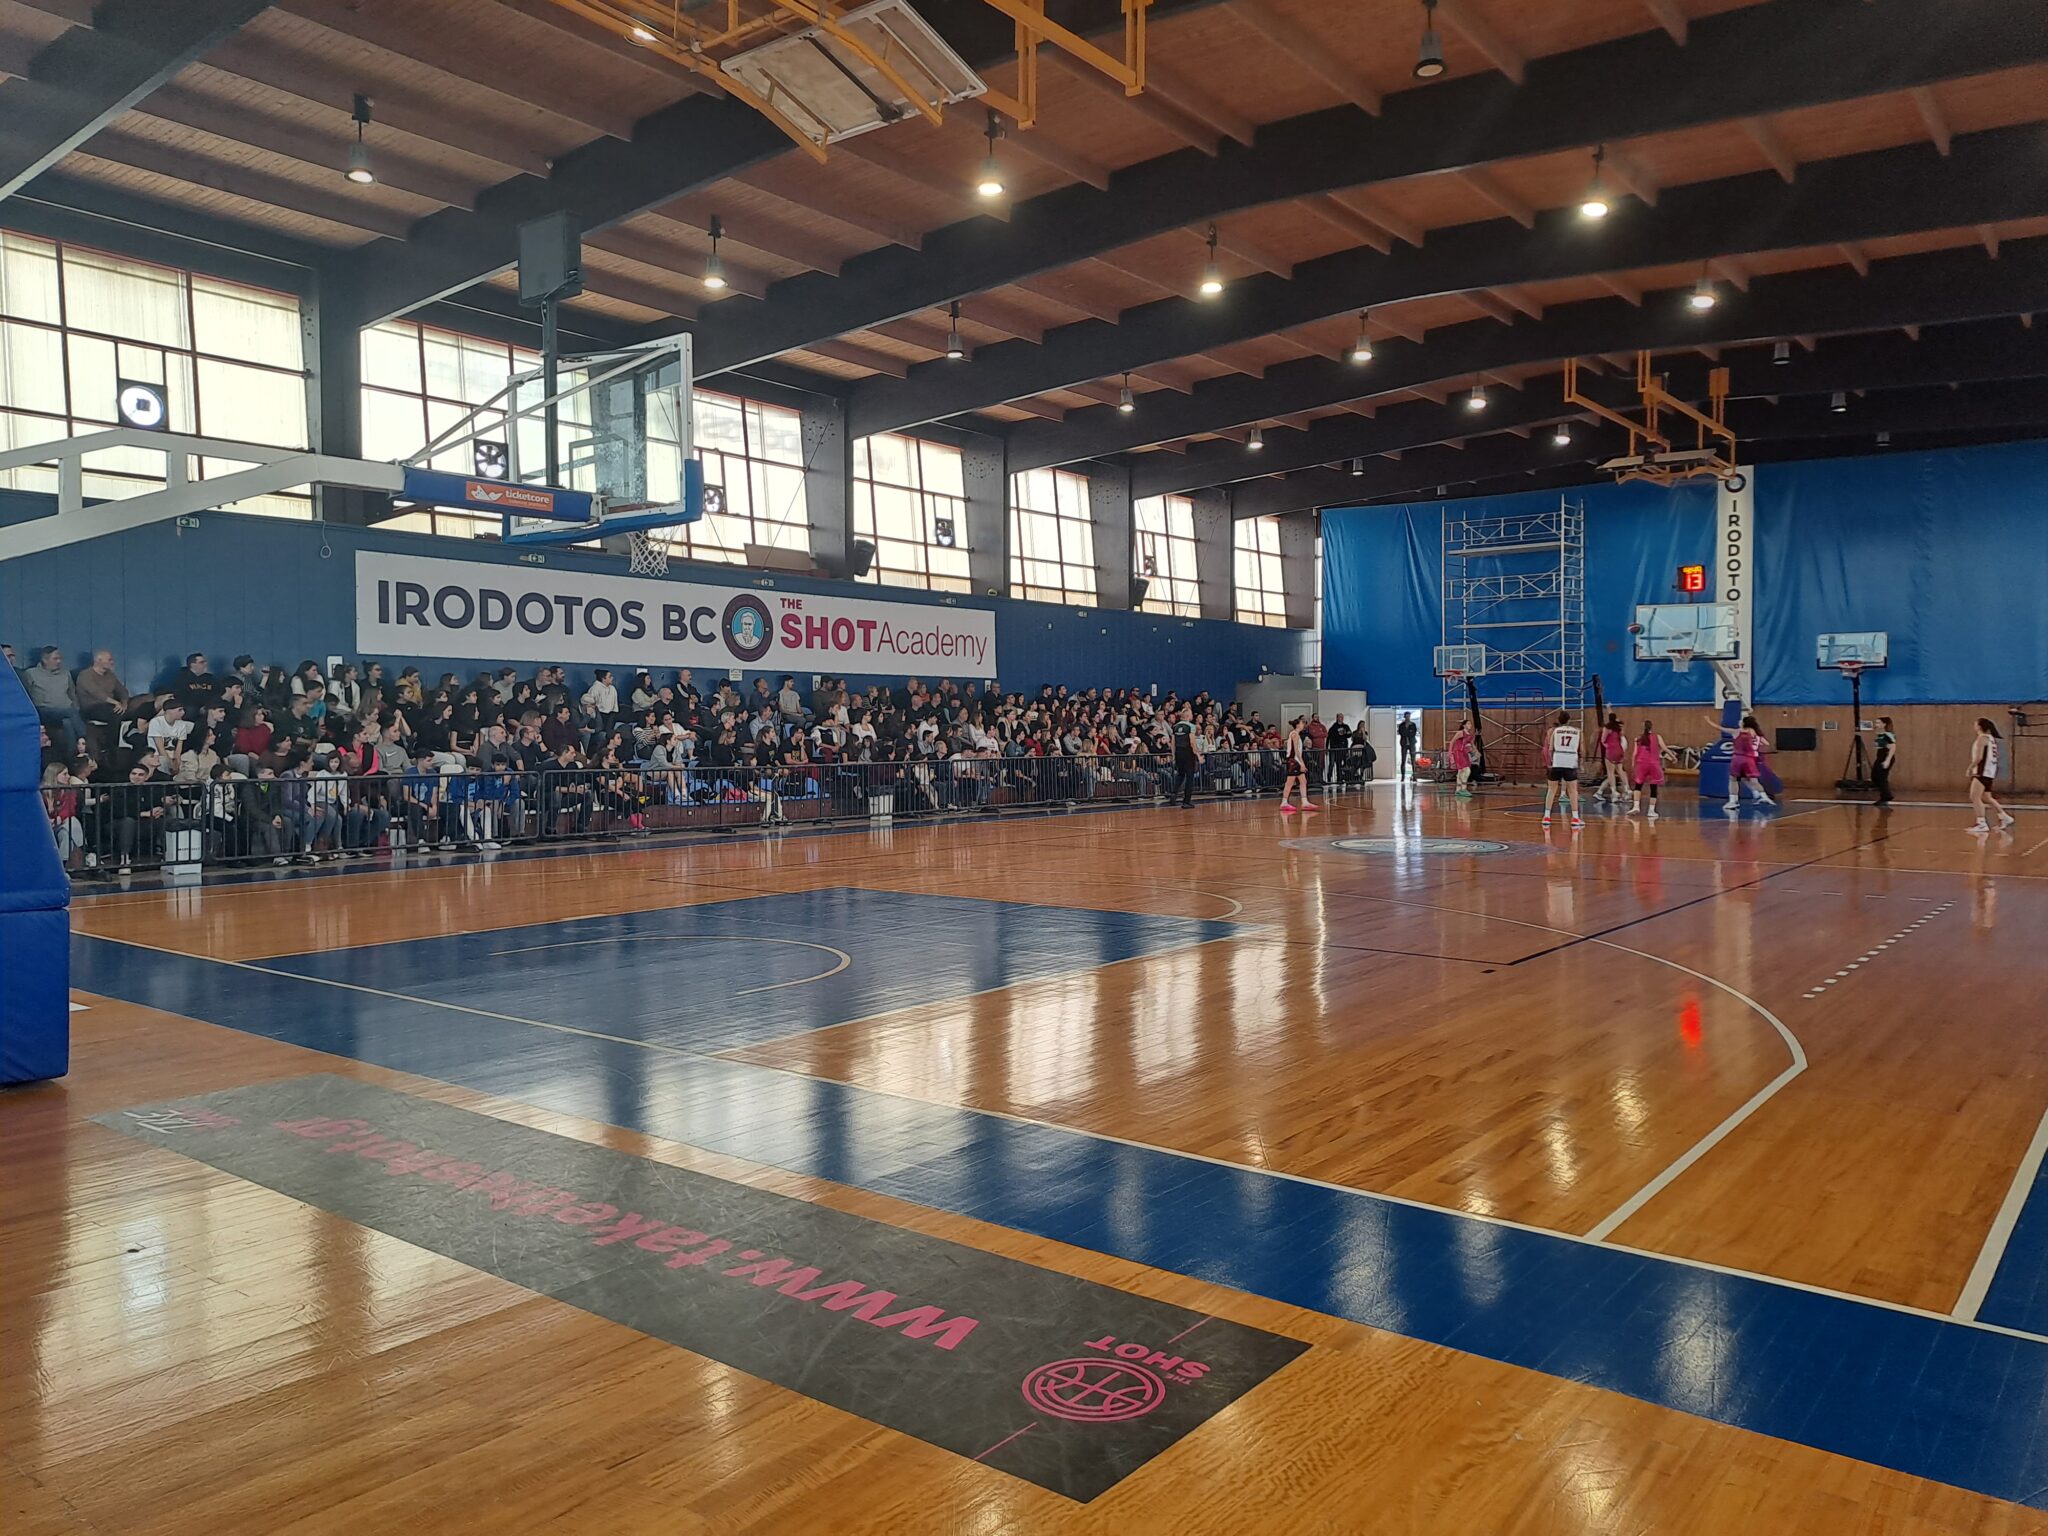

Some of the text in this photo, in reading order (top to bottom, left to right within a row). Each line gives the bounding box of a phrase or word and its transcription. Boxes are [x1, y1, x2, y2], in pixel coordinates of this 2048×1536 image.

[505, 489, 550, 504] ticketcore
[1687, 574, 1702, 590] 13
[779, 597, 804, 610] THE
[377, 579, 717, 644] IRODOTOS BC
[1560, 735, 1573, 747] 17
[1083, 1335, 1211, 1379] SHOT
